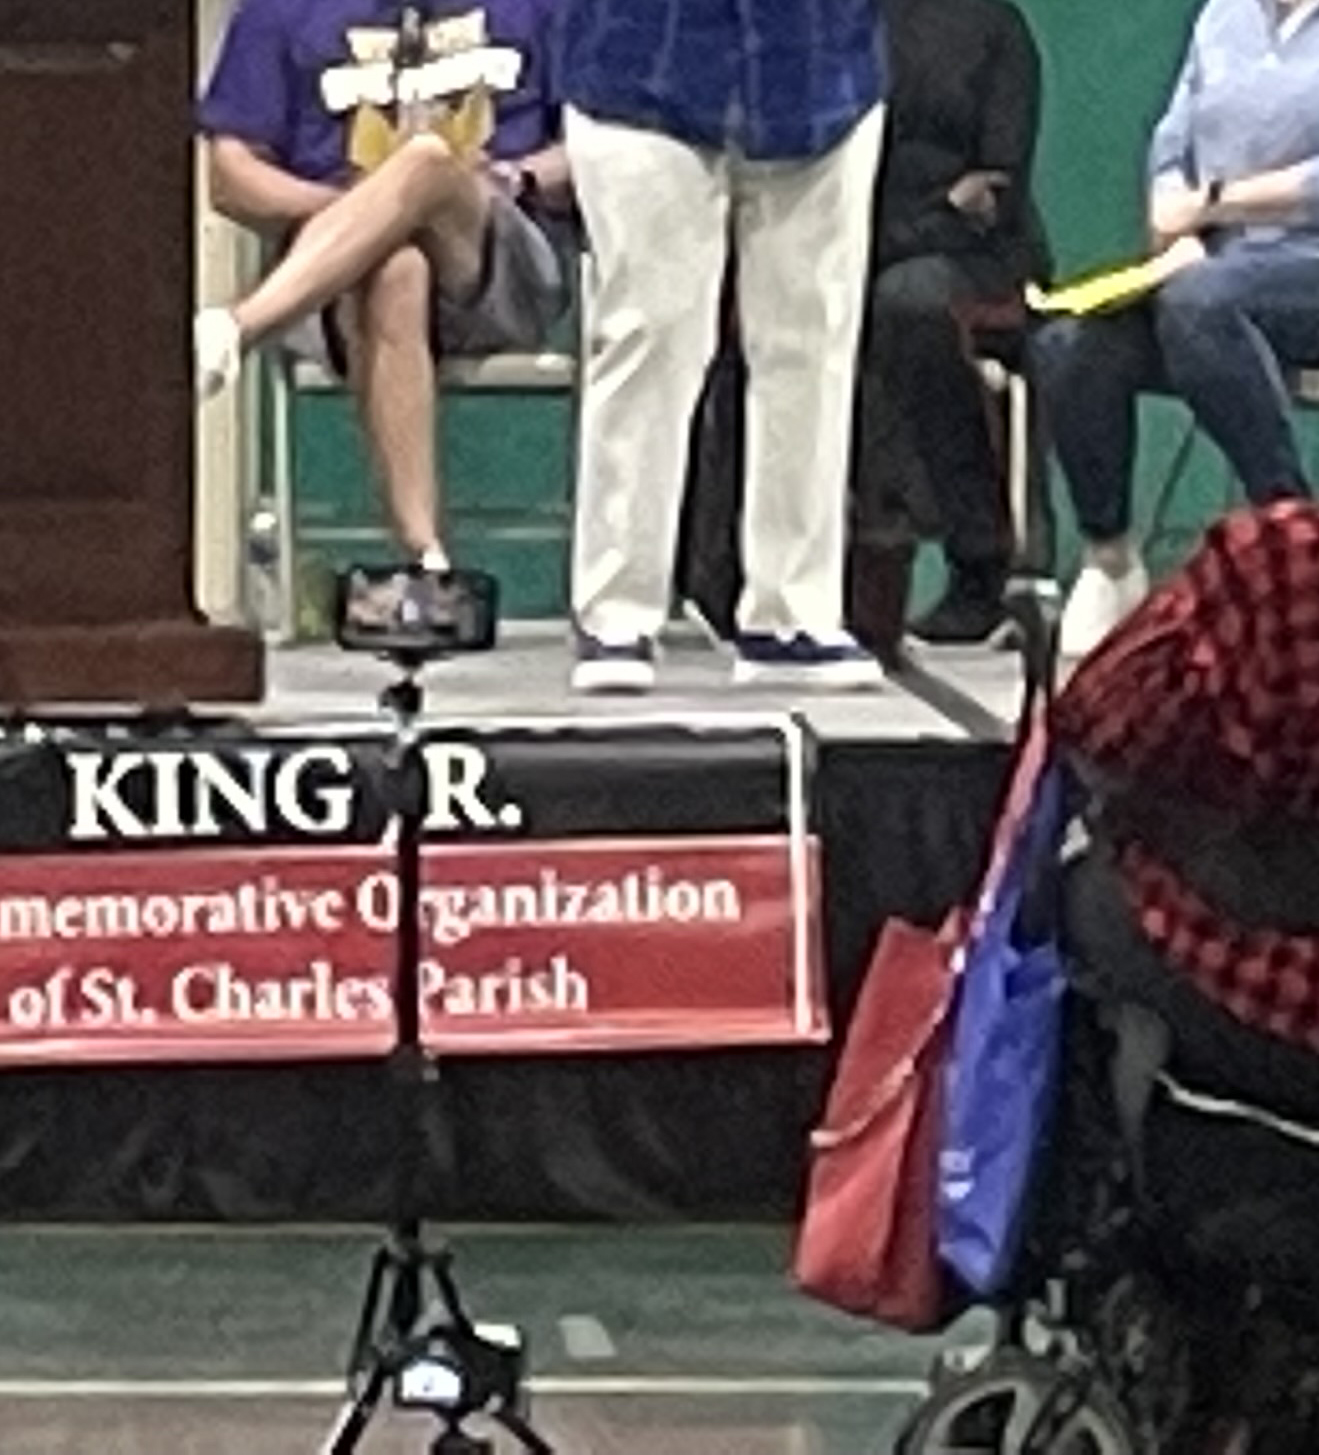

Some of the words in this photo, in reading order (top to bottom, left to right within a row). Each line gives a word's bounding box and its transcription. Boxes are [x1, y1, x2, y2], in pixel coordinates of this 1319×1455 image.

[66, 745, 354, 838] KING
[380, 741, 522, 846] R.
[8, 965, 76, 1029] of
[80, 967, 158, 1027] St.
[172, 960, 395, 1024] Charles
[417, 952, 589, 1021] Parish
